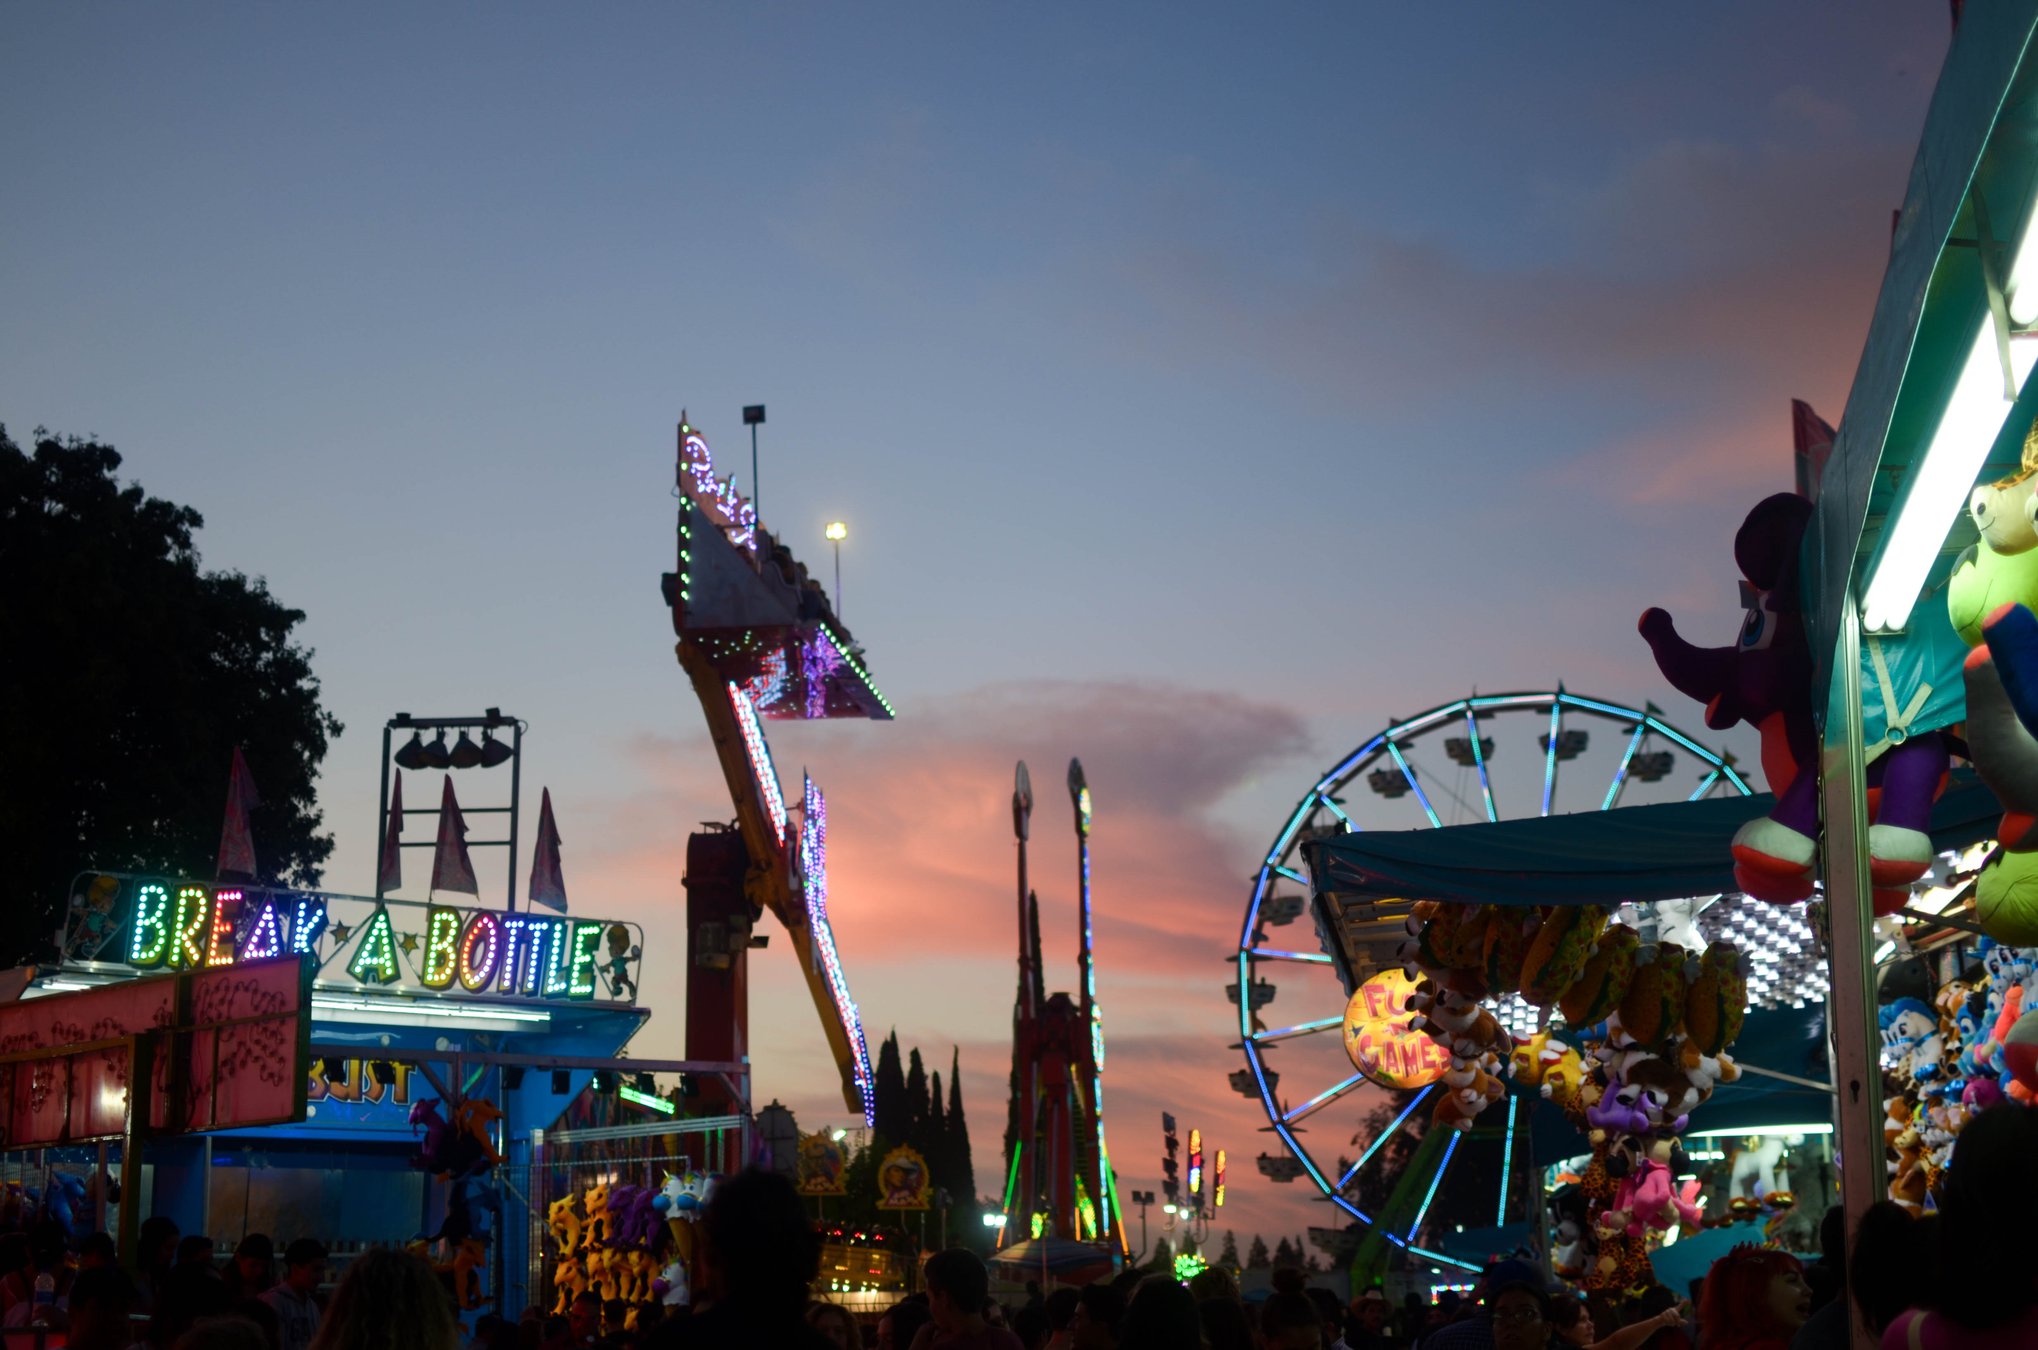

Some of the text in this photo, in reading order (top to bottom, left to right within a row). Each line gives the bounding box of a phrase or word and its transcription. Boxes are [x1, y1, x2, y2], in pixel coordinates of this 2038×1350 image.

[128, 879, 602, 1000] BREAK A BOTTLE
[1363, 984, 1417, 1017] FU
